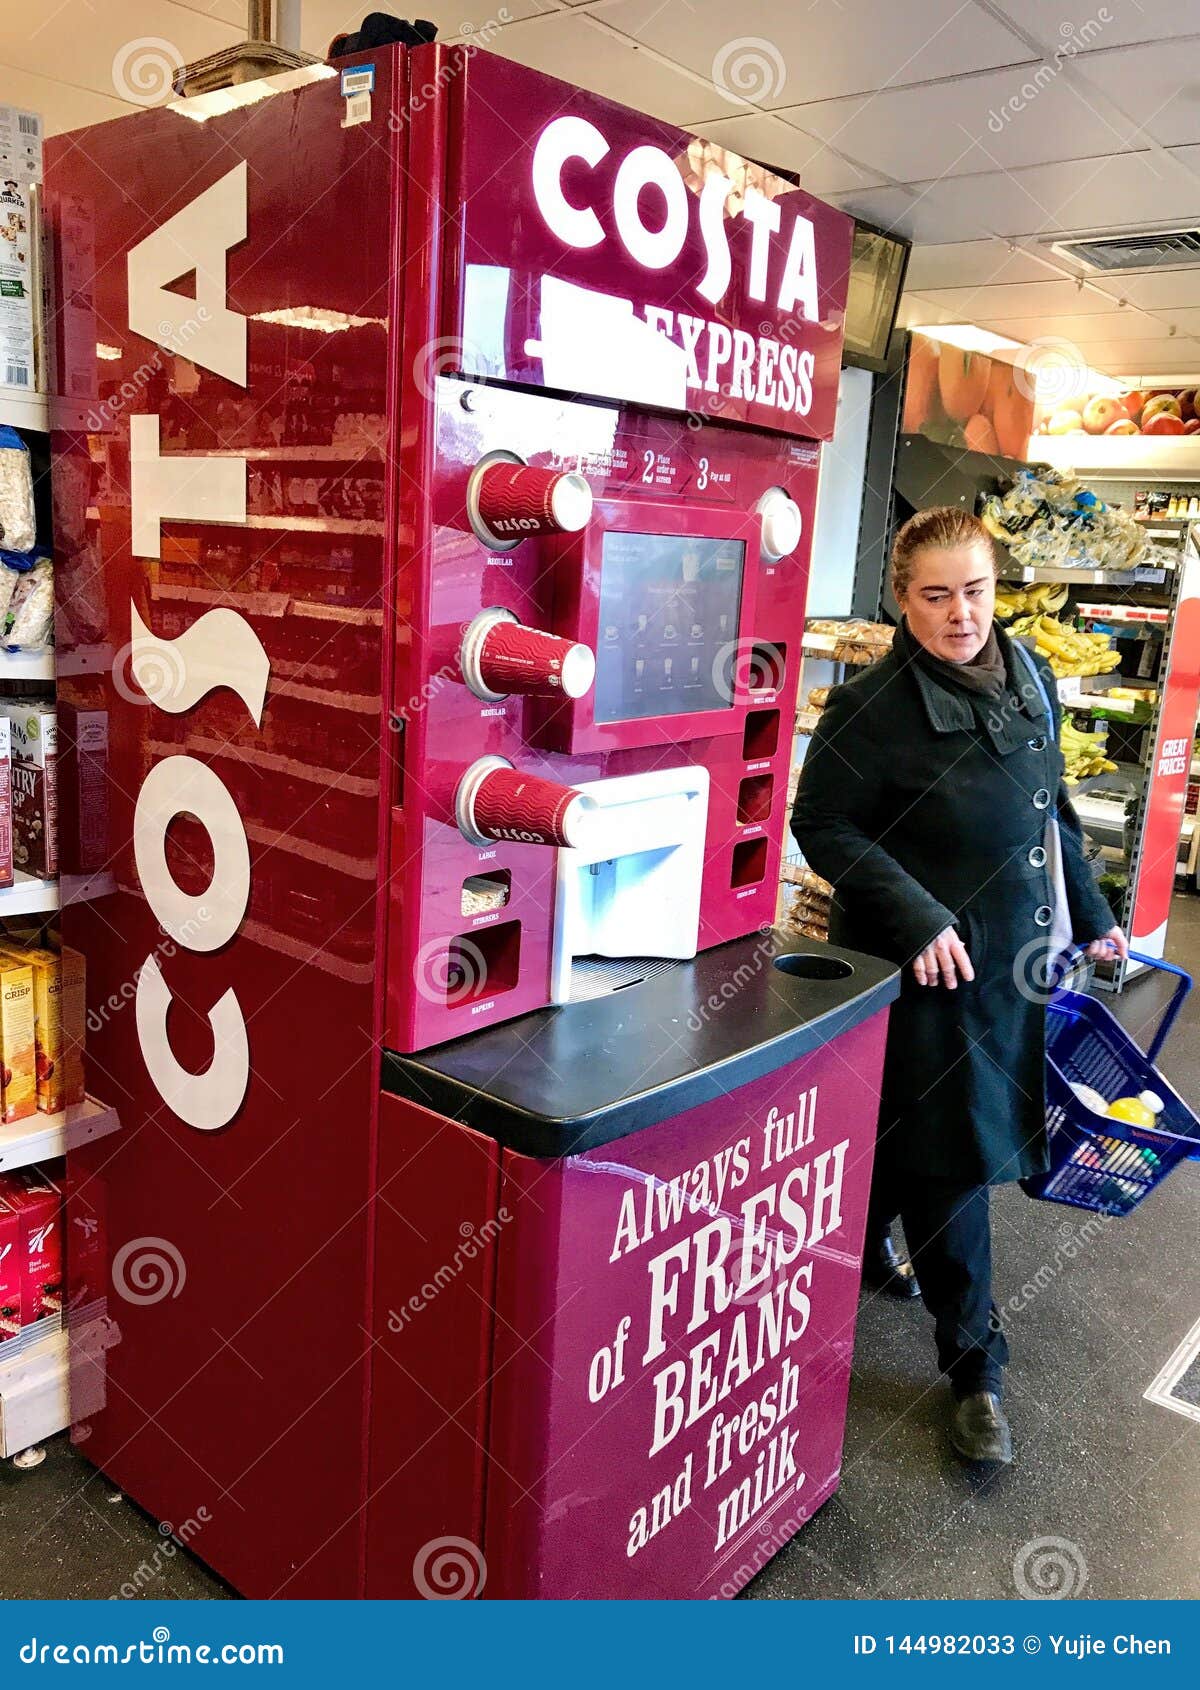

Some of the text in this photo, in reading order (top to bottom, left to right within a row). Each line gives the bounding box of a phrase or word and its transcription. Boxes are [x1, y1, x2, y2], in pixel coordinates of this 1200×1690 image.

[531, 115, 820, 323] COSTA
[642, 450, 655, 484] 2
[696, 457, 709, 490] 3
[492, 517, 541, 532] COSTA
[487, 557, 514, 567] REGULAR
[128, 159, 270, 1130] COSTA
[1162, 738, 1188, 757] GREAT
[1157, 756, 1186, 777] PRICES
[488, 827, 545, 843] COSTA
[4, 986, 31, 1001] CRISP
[609, 1086, 818, 1264] Always full
[588, 1139, 850, 1403] of FRESH
[648, 1260, 814, 1458] BEANS
[626, 1356, 800, 1558] and fresh
